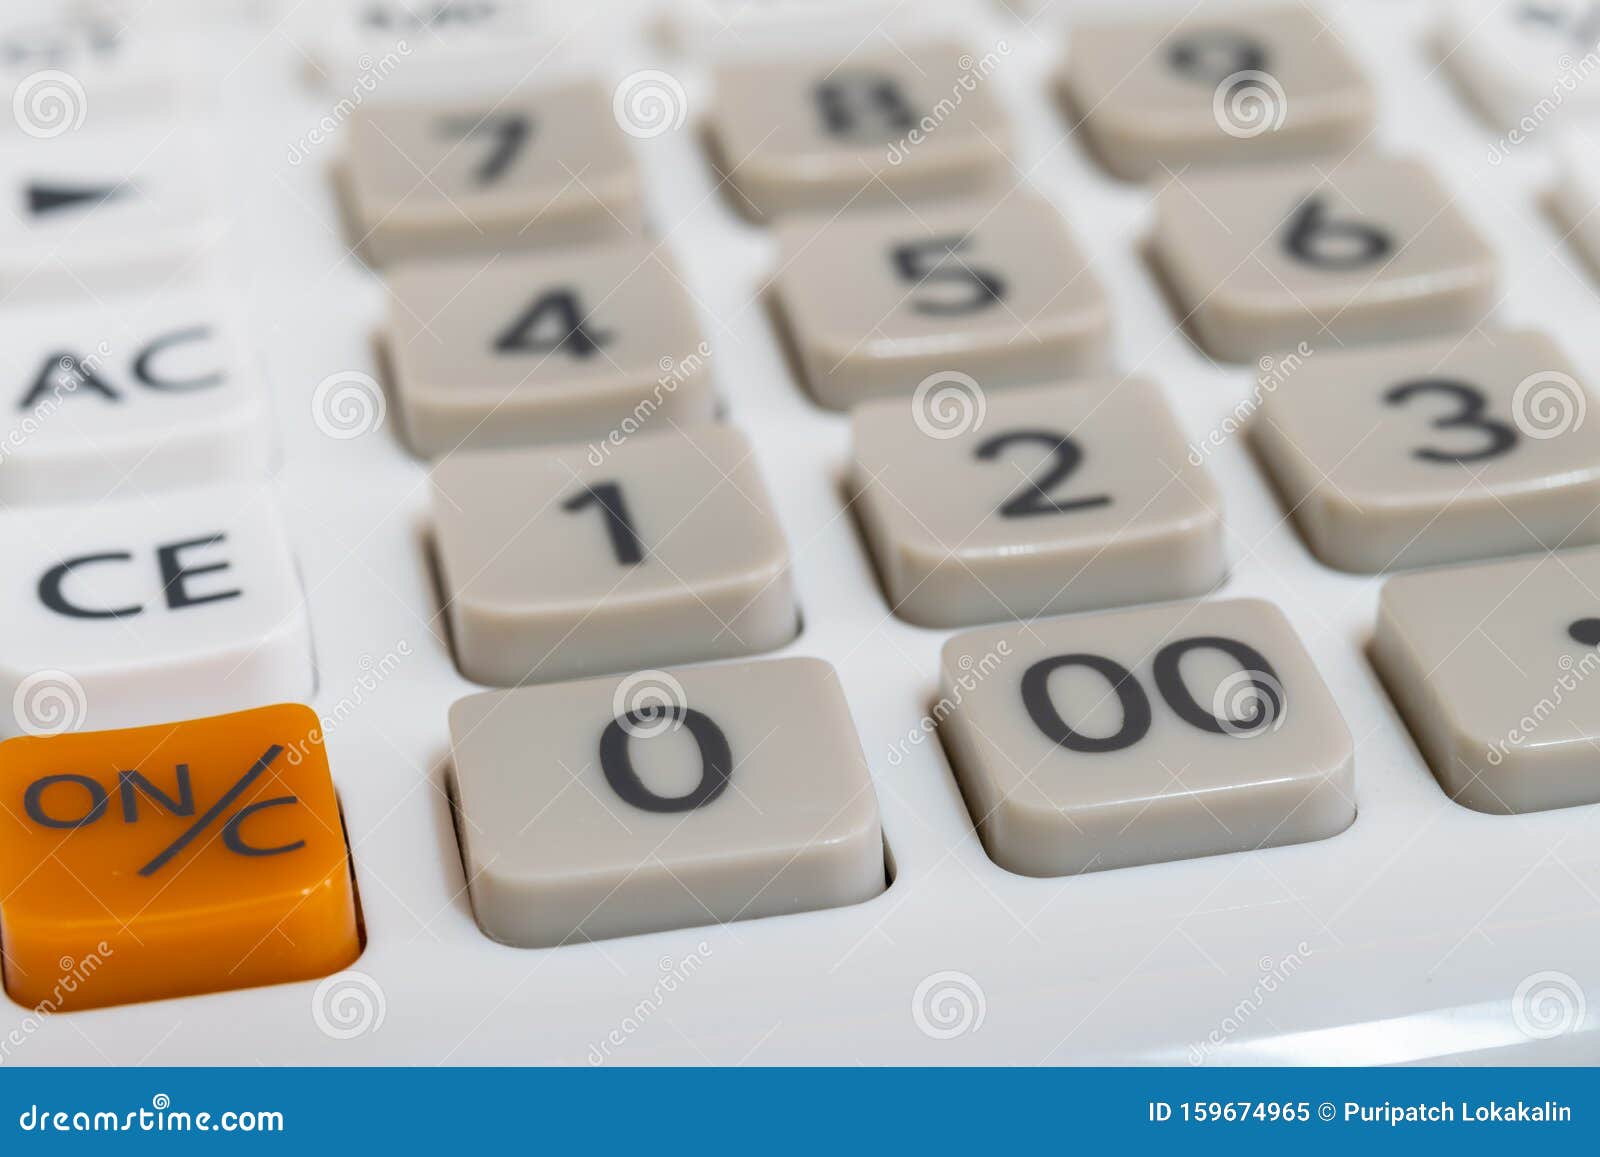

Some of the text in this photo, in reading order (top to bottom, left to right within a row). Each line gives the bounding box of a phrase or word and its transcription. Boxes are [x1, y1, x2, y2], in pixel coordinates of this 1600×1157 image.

[430, 112, 536, 188] 7
[813, 70, 919, 145] 8
[890, 236, 1006, 316] 5
[1280, 198, 1392, 272] 6
[490, 288, 614, 360] 4
[17, 326, 226, 410] AC
[1382, 378, 1522, 464] 3
[972, 430, 1112, 518] 2
[560, 480, 644, 566] 1
[36, 532, 243, 619] CE
[1019, 636, 1284, 753] 00
[600, 706, 732, 813] 0
